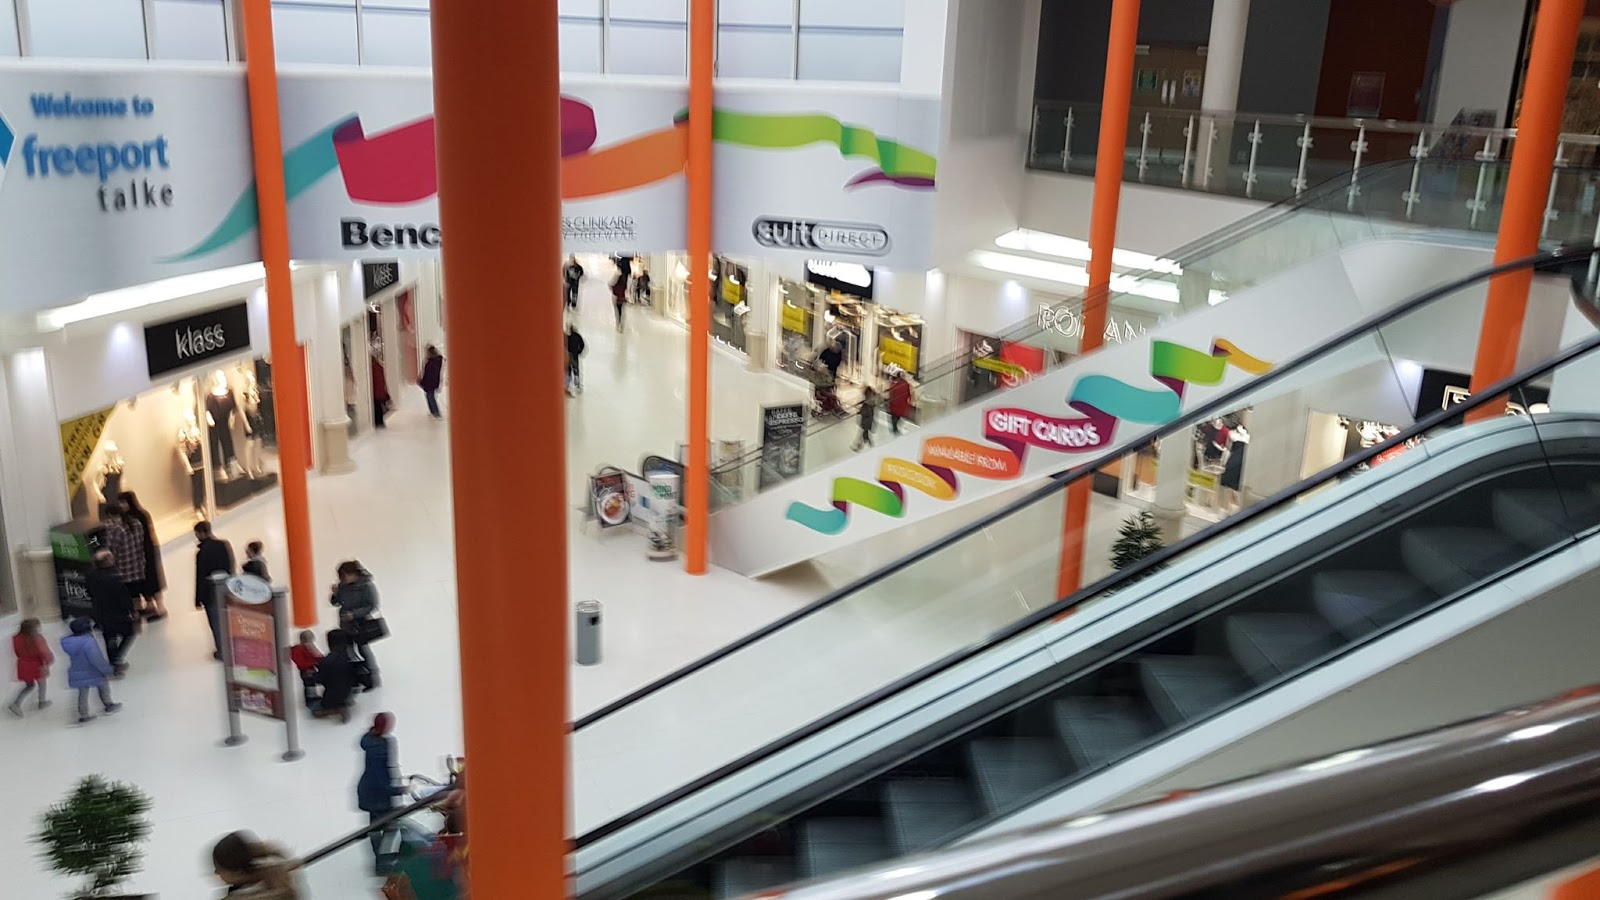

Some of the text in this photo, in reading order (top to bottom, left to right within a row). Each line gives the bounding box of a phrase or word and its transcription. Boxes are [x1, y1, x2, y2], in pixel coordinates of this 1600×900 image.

[31, 93, 154, 117] Welcome to
[22, 133, 169, 182] freeport
[98, 178, 174, 211] talke
[757, 219, 882, 249] suit DIRECT
[175, 323, 225, 359] klass
[988, 410, 1101, 447] GIFT CARDS
